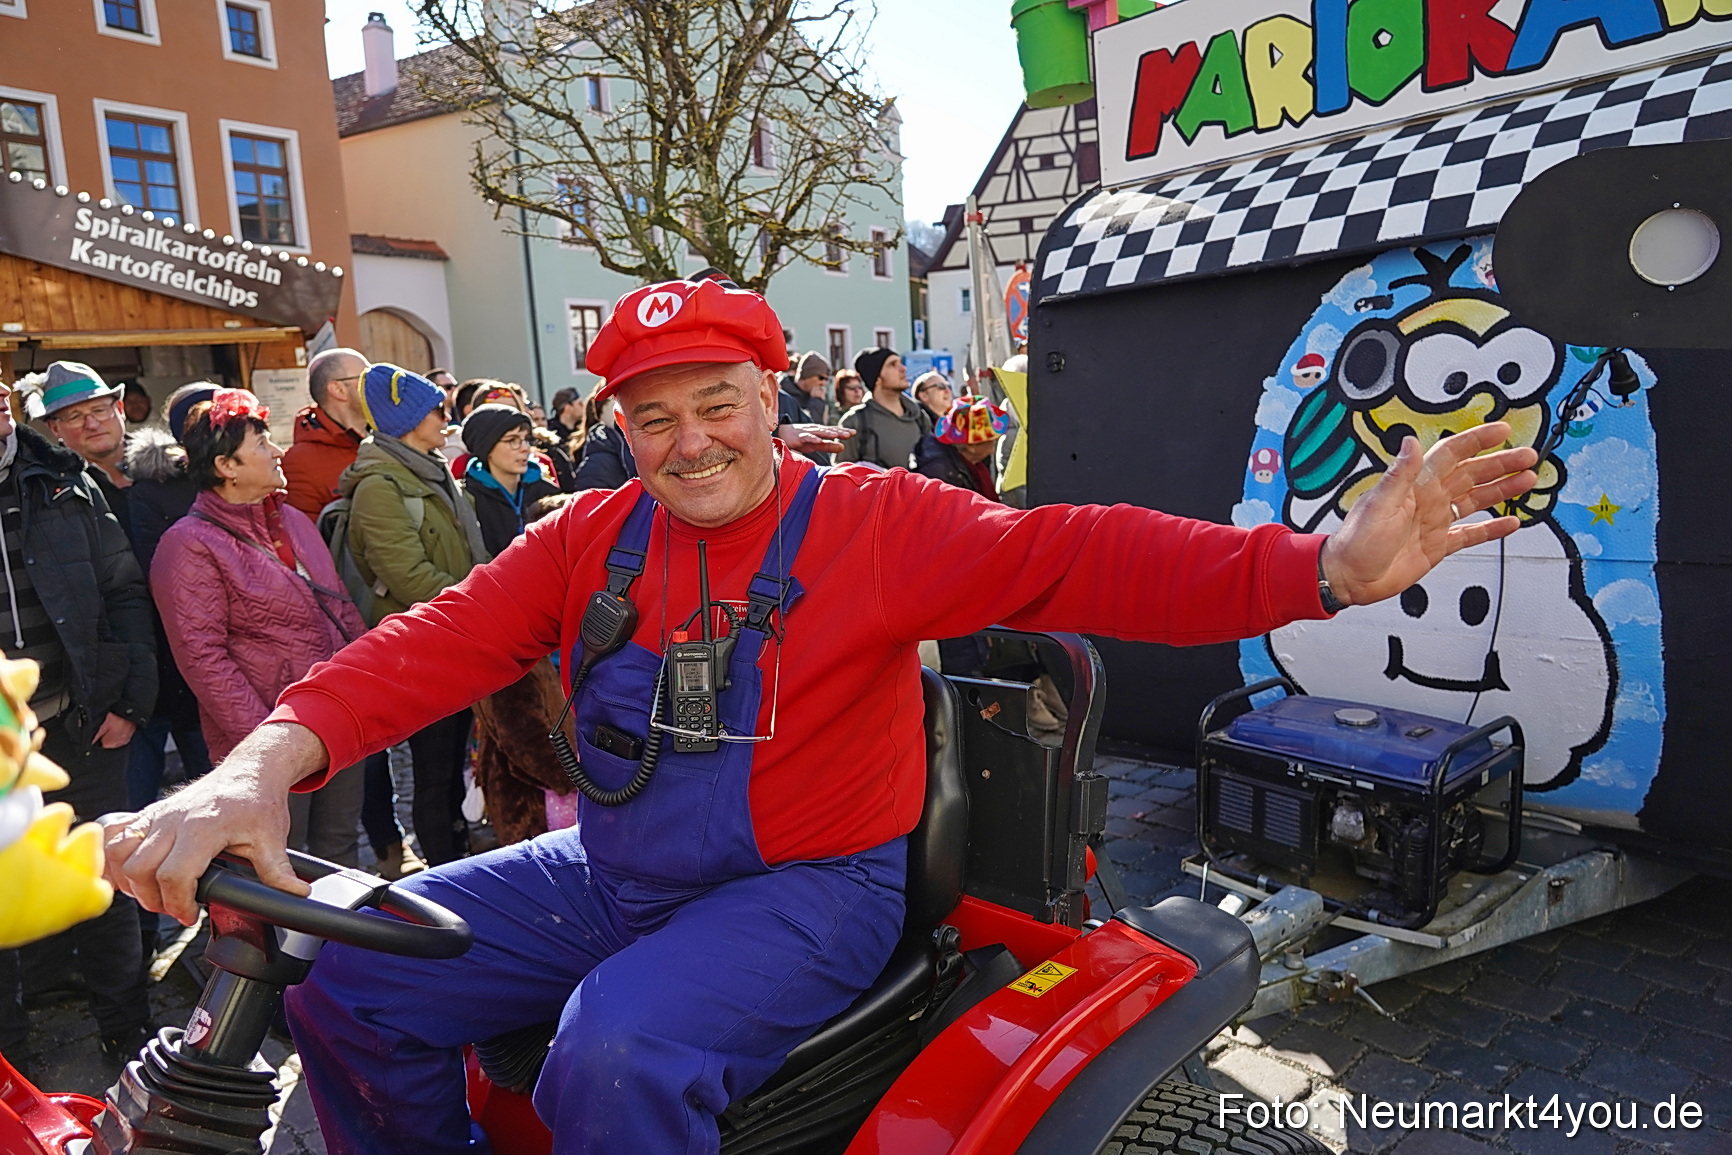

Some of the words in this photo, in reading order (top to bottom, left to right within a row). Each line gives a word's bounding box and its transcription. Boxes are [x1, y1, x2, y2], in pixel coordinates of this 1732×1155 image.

[1125, 0, 1732, 161] MARIOKA
[70, 237, 258, 308] Kartoffelchips
[74, 207, 282, 285] Spiralkartoffeln
[645, 295, 674, 322] M
